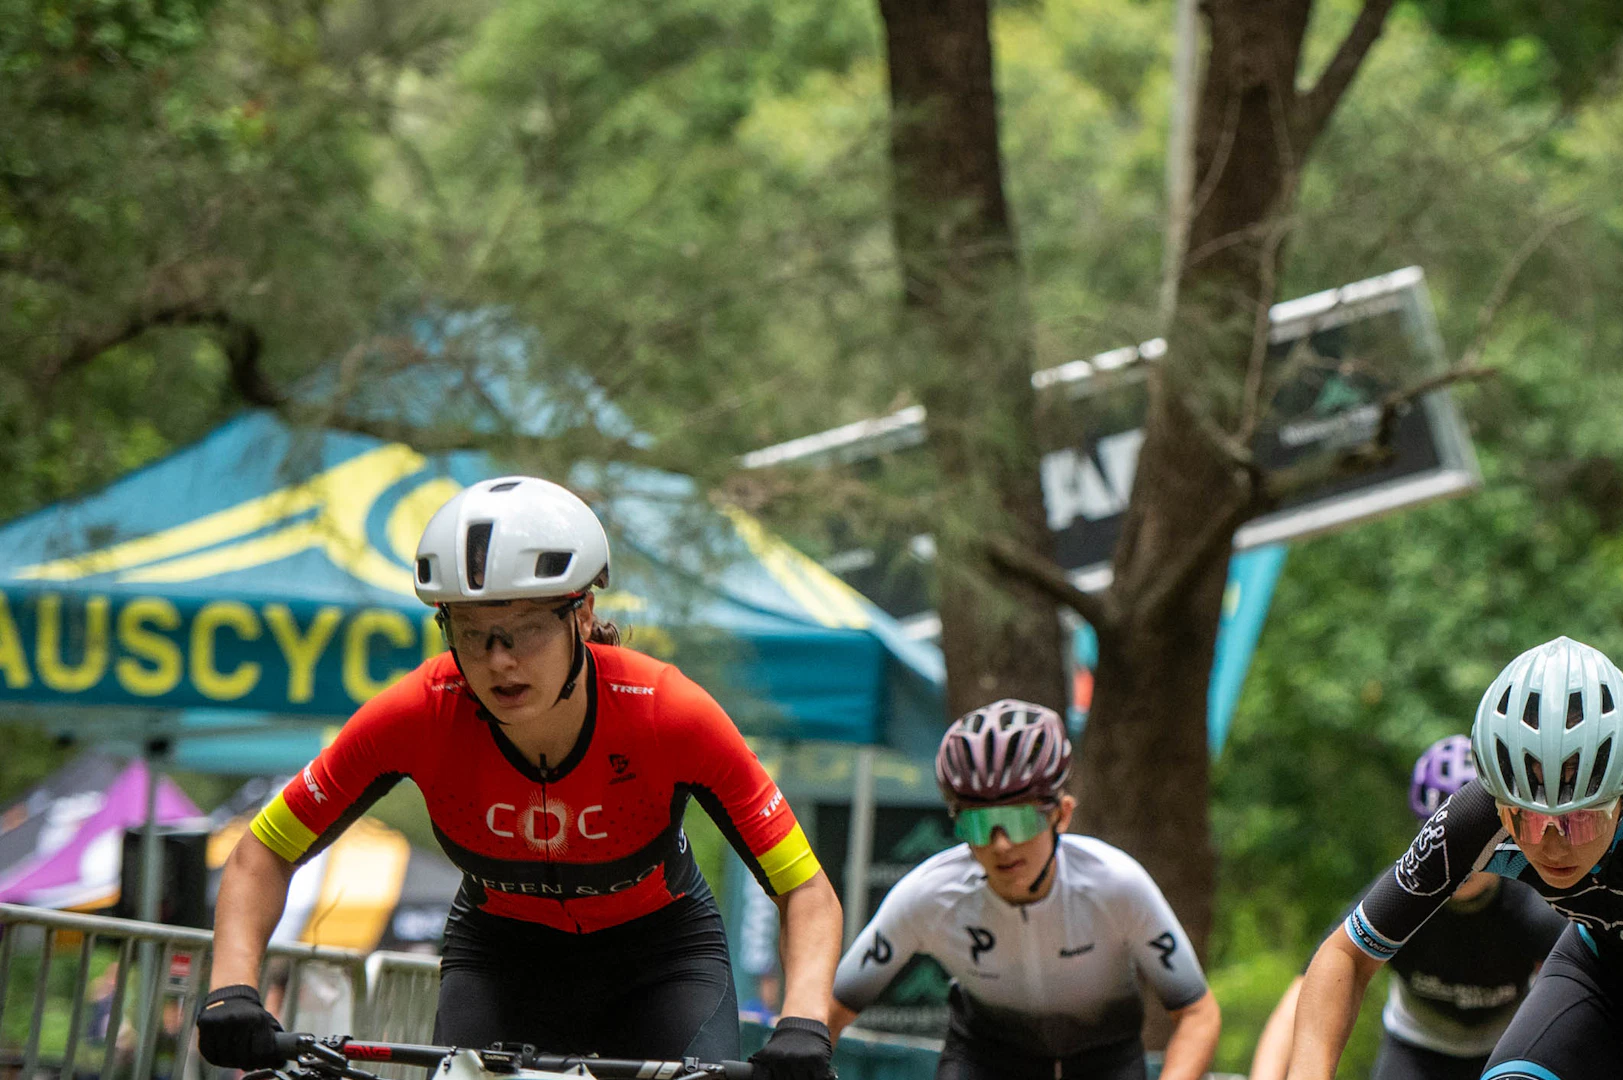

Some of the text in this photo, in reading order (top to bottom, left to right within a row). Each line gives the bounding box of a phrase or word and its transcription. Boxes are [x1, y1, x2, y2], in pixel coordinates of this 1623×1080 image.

[0, 592, 450, 703] AUSCYC
[609, 683, 655, 696] TREK
[575, 885, 601, 896] &
